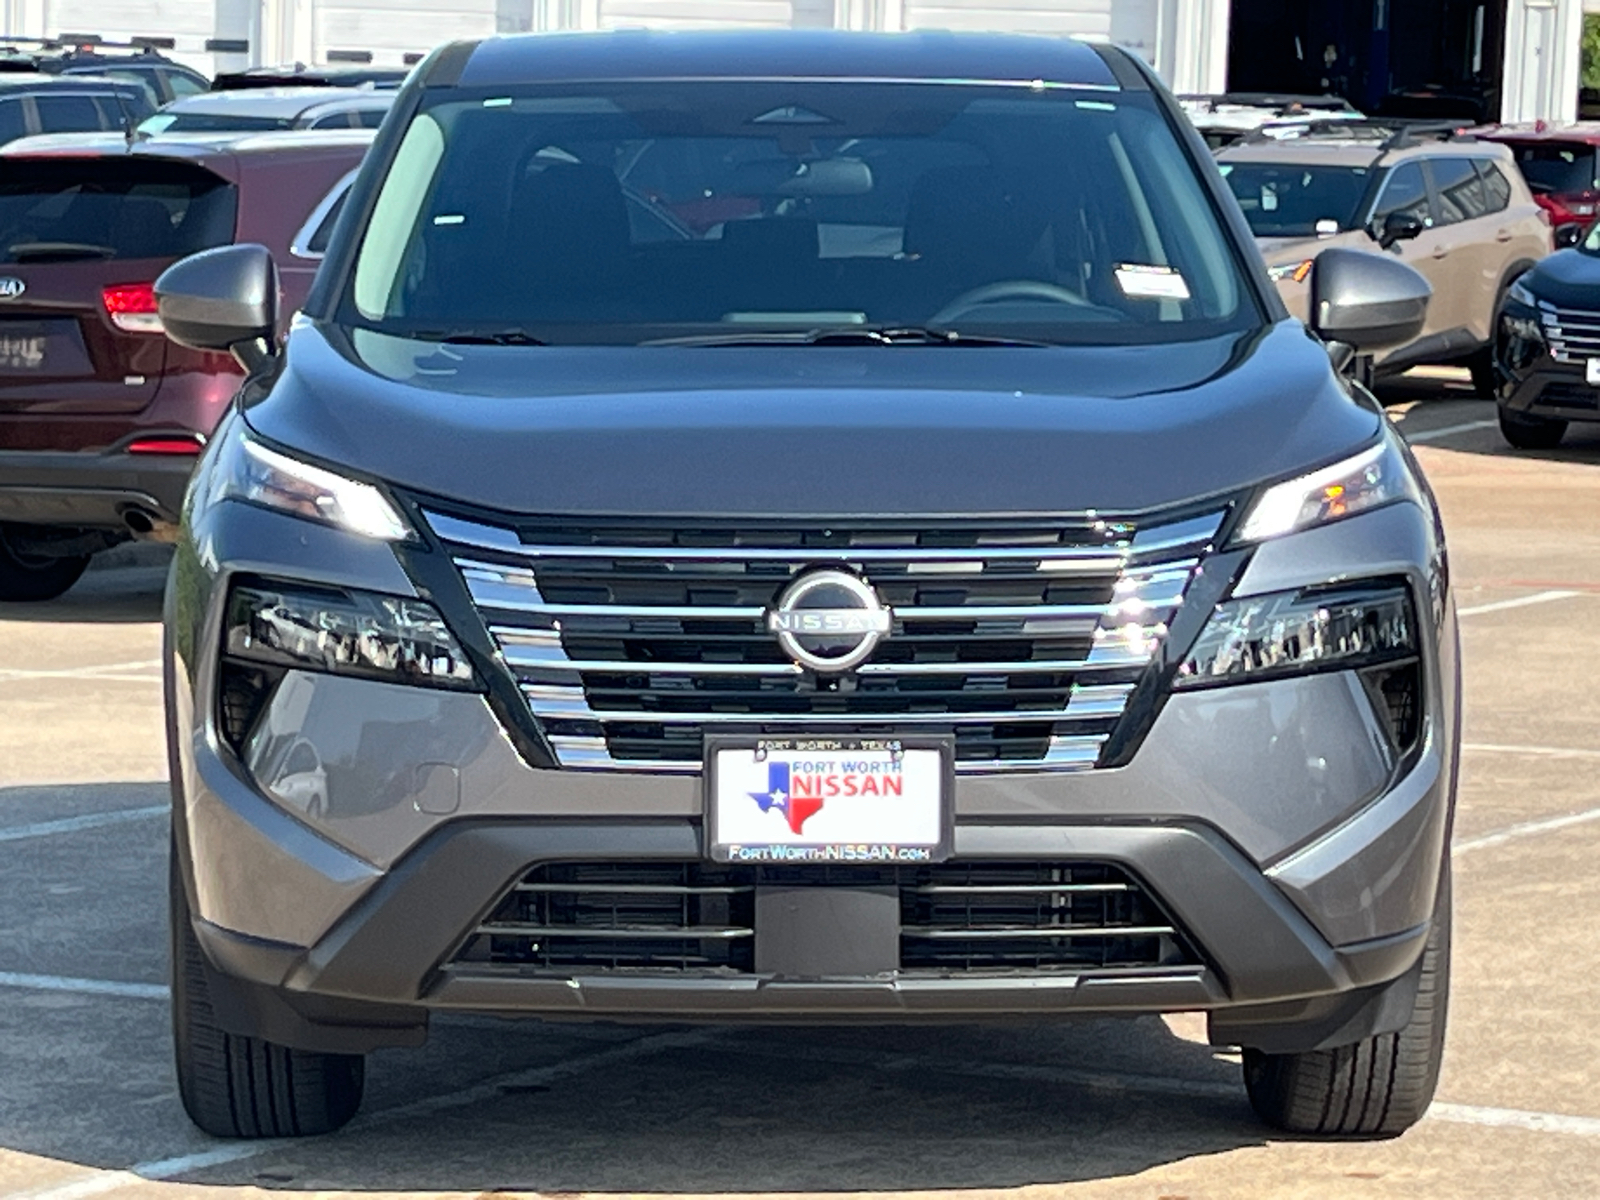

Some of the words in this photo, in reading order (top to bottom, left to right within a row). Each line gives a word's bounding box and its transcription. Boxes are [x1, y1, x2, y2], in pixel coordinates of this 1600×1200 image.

[770, 613, 888, 630] NISSAN
[758, 741, 790, 750] FORT
[796, 741, 841, 750] WORTH
[792, 761, 835, 773] FORT
[842, 761, 902, 773] WORTH
[792, 775, 902, 796] NISSAN
